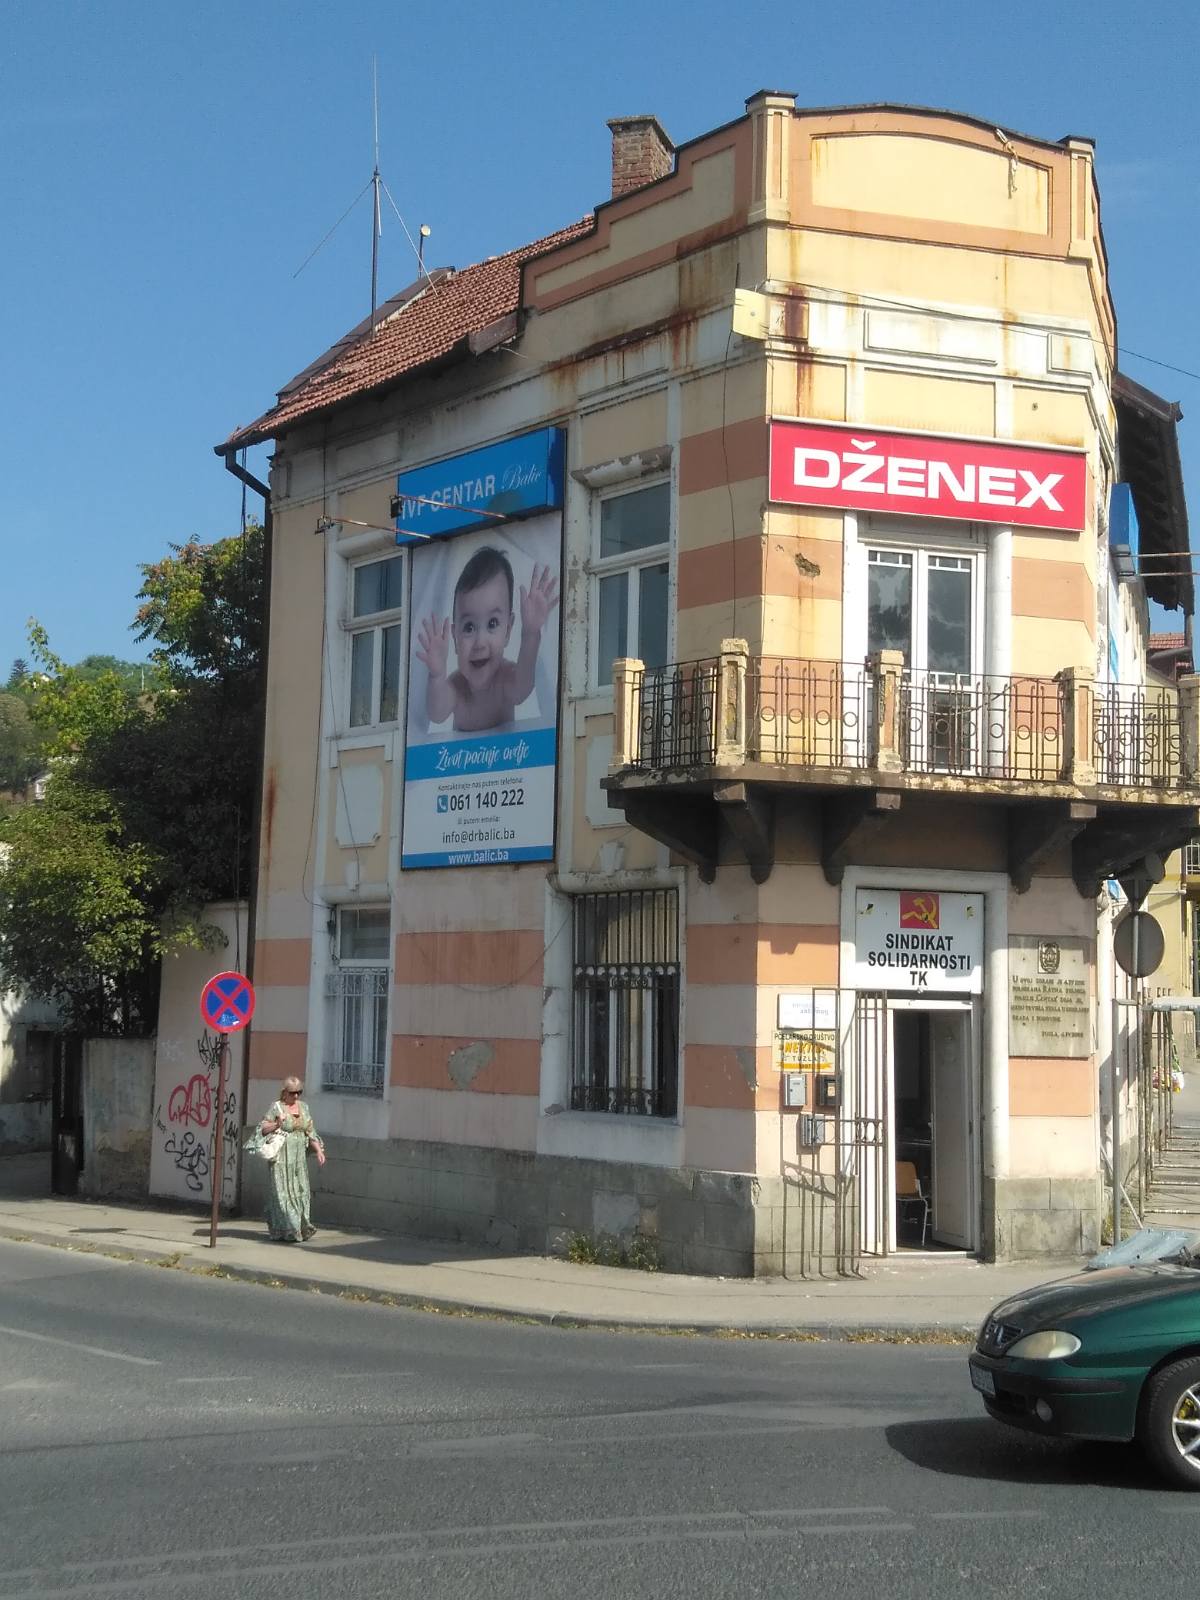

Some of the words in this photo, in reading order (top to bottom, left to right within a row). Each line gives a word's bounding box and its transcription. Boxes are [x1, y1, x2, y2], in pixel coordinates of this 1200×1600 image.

[793, 438, 1065, 512] DŽENEX
[431, 474, 496, 512] CENTAR
[435, 744, 464, 771] Život
[463, 746, 500, 771] počinje
[503, 739, 530, 766] ovdje
[450, 794, 471, 811] 061
[475, 791, 498, 809] 140
[501, 788, 524, 807] 222
[442, 828, 515, 844] info@drbalic.ba
[448, 849, 509, 865] www.balic.ba
[885, 933, 954, 951] SINDIKAT
[868, 951, 971, 970] SOLIDARNOSTI
[909, 971, 928, 986] TK
[774, 1032, 808, 1041] PČELARSKO
